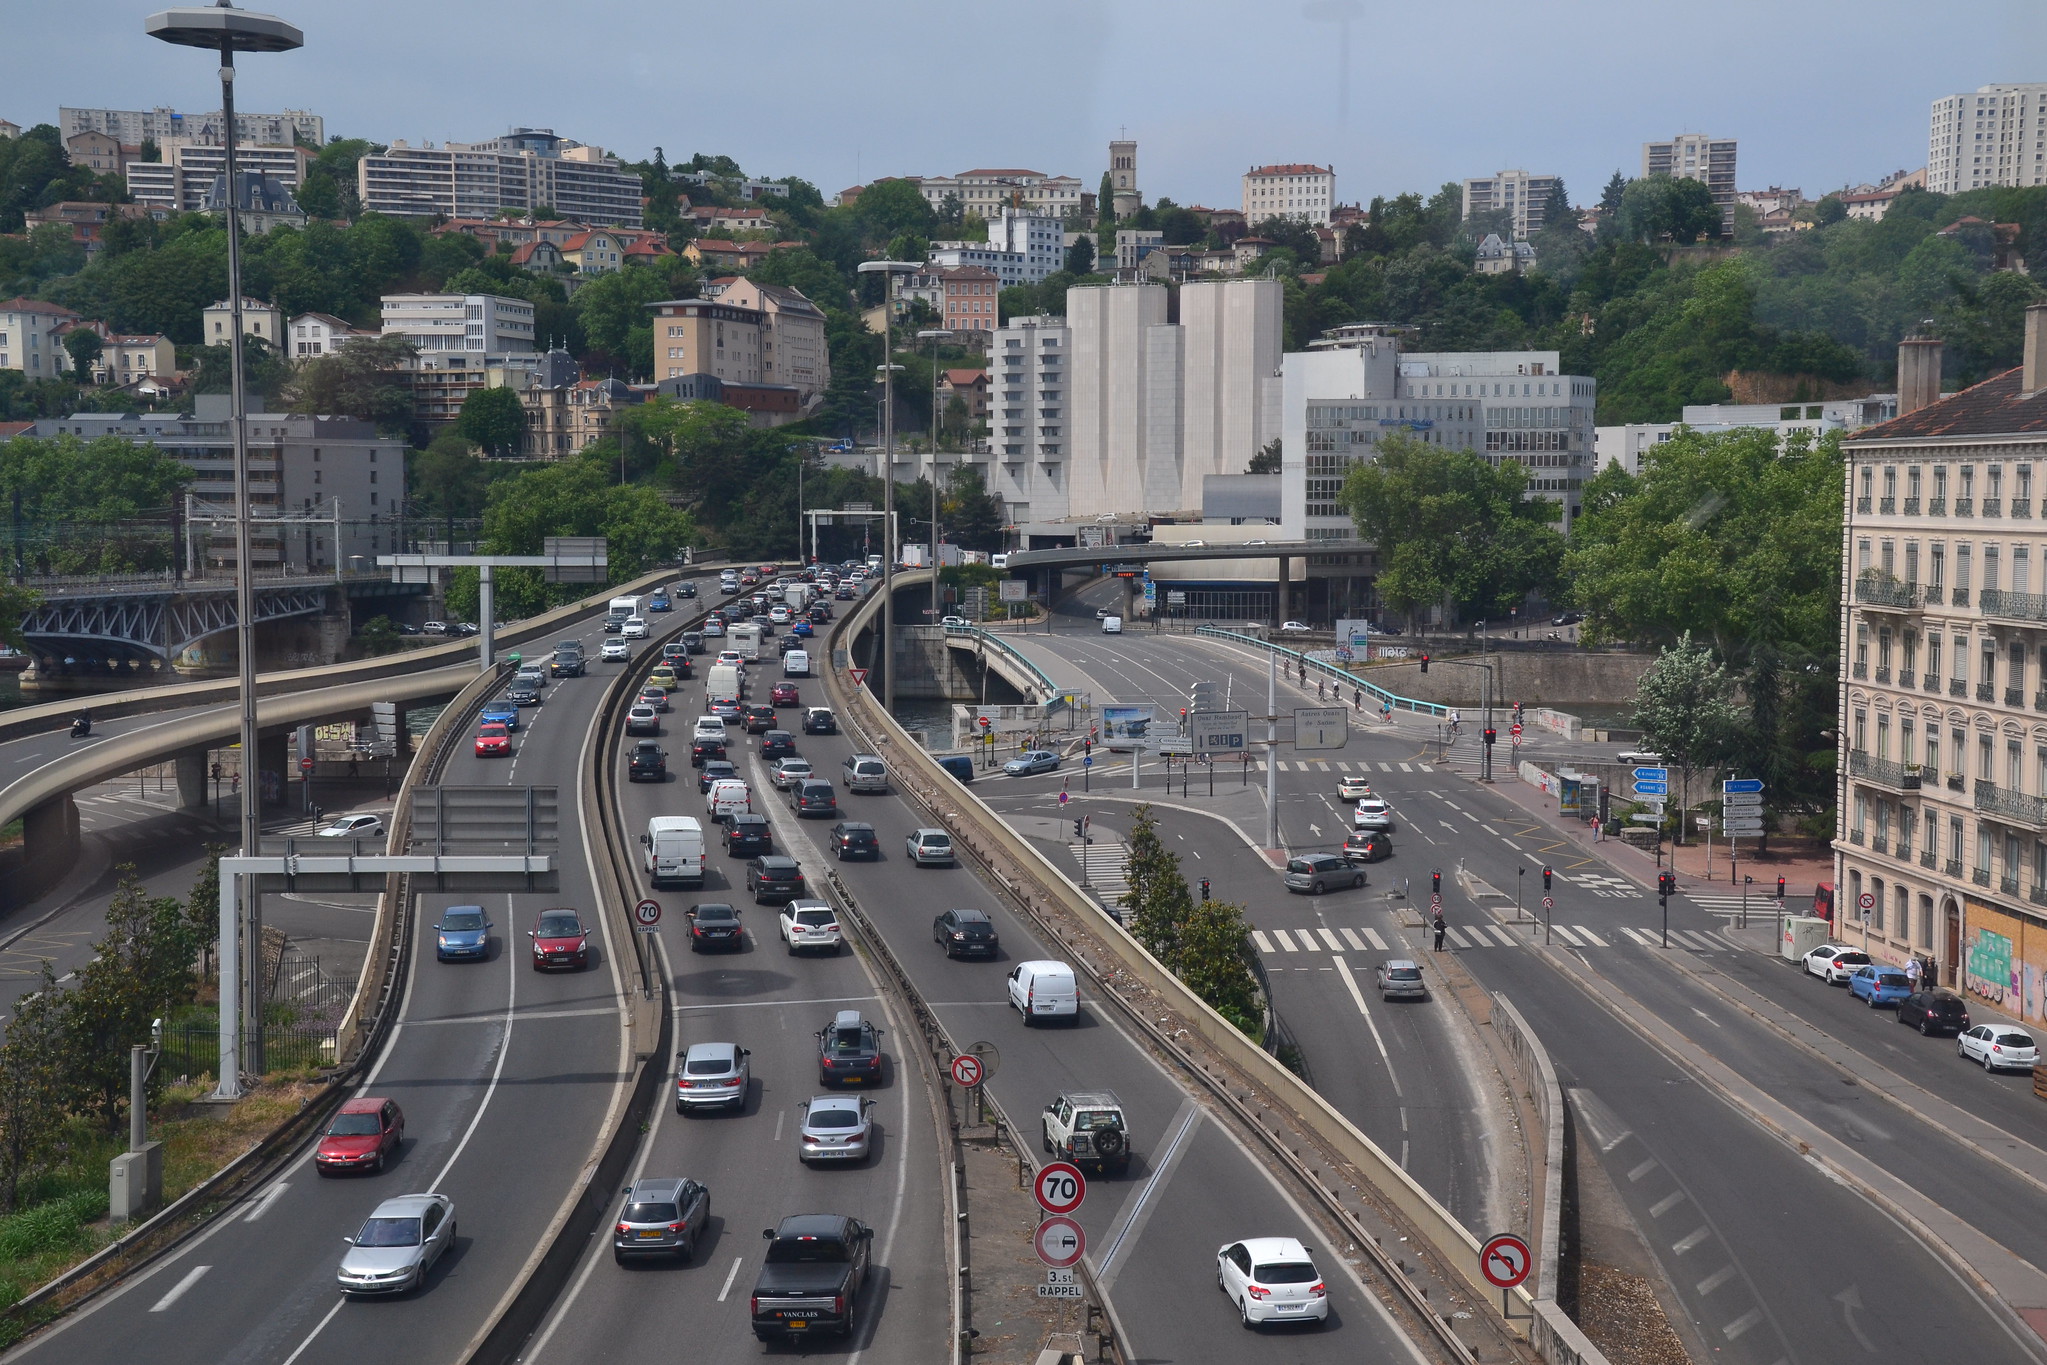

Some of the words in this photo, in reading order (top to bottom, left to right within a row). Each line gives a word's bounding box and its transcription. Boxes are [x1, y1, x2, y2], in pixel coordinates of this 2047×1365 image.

[1592, 889, 1644, 898] BUS
[641, 906, 657, 918] 70
[1046, 1177, 1077, 1199] 70
[1040, 1286, 1081, 1296] RAPPEL
